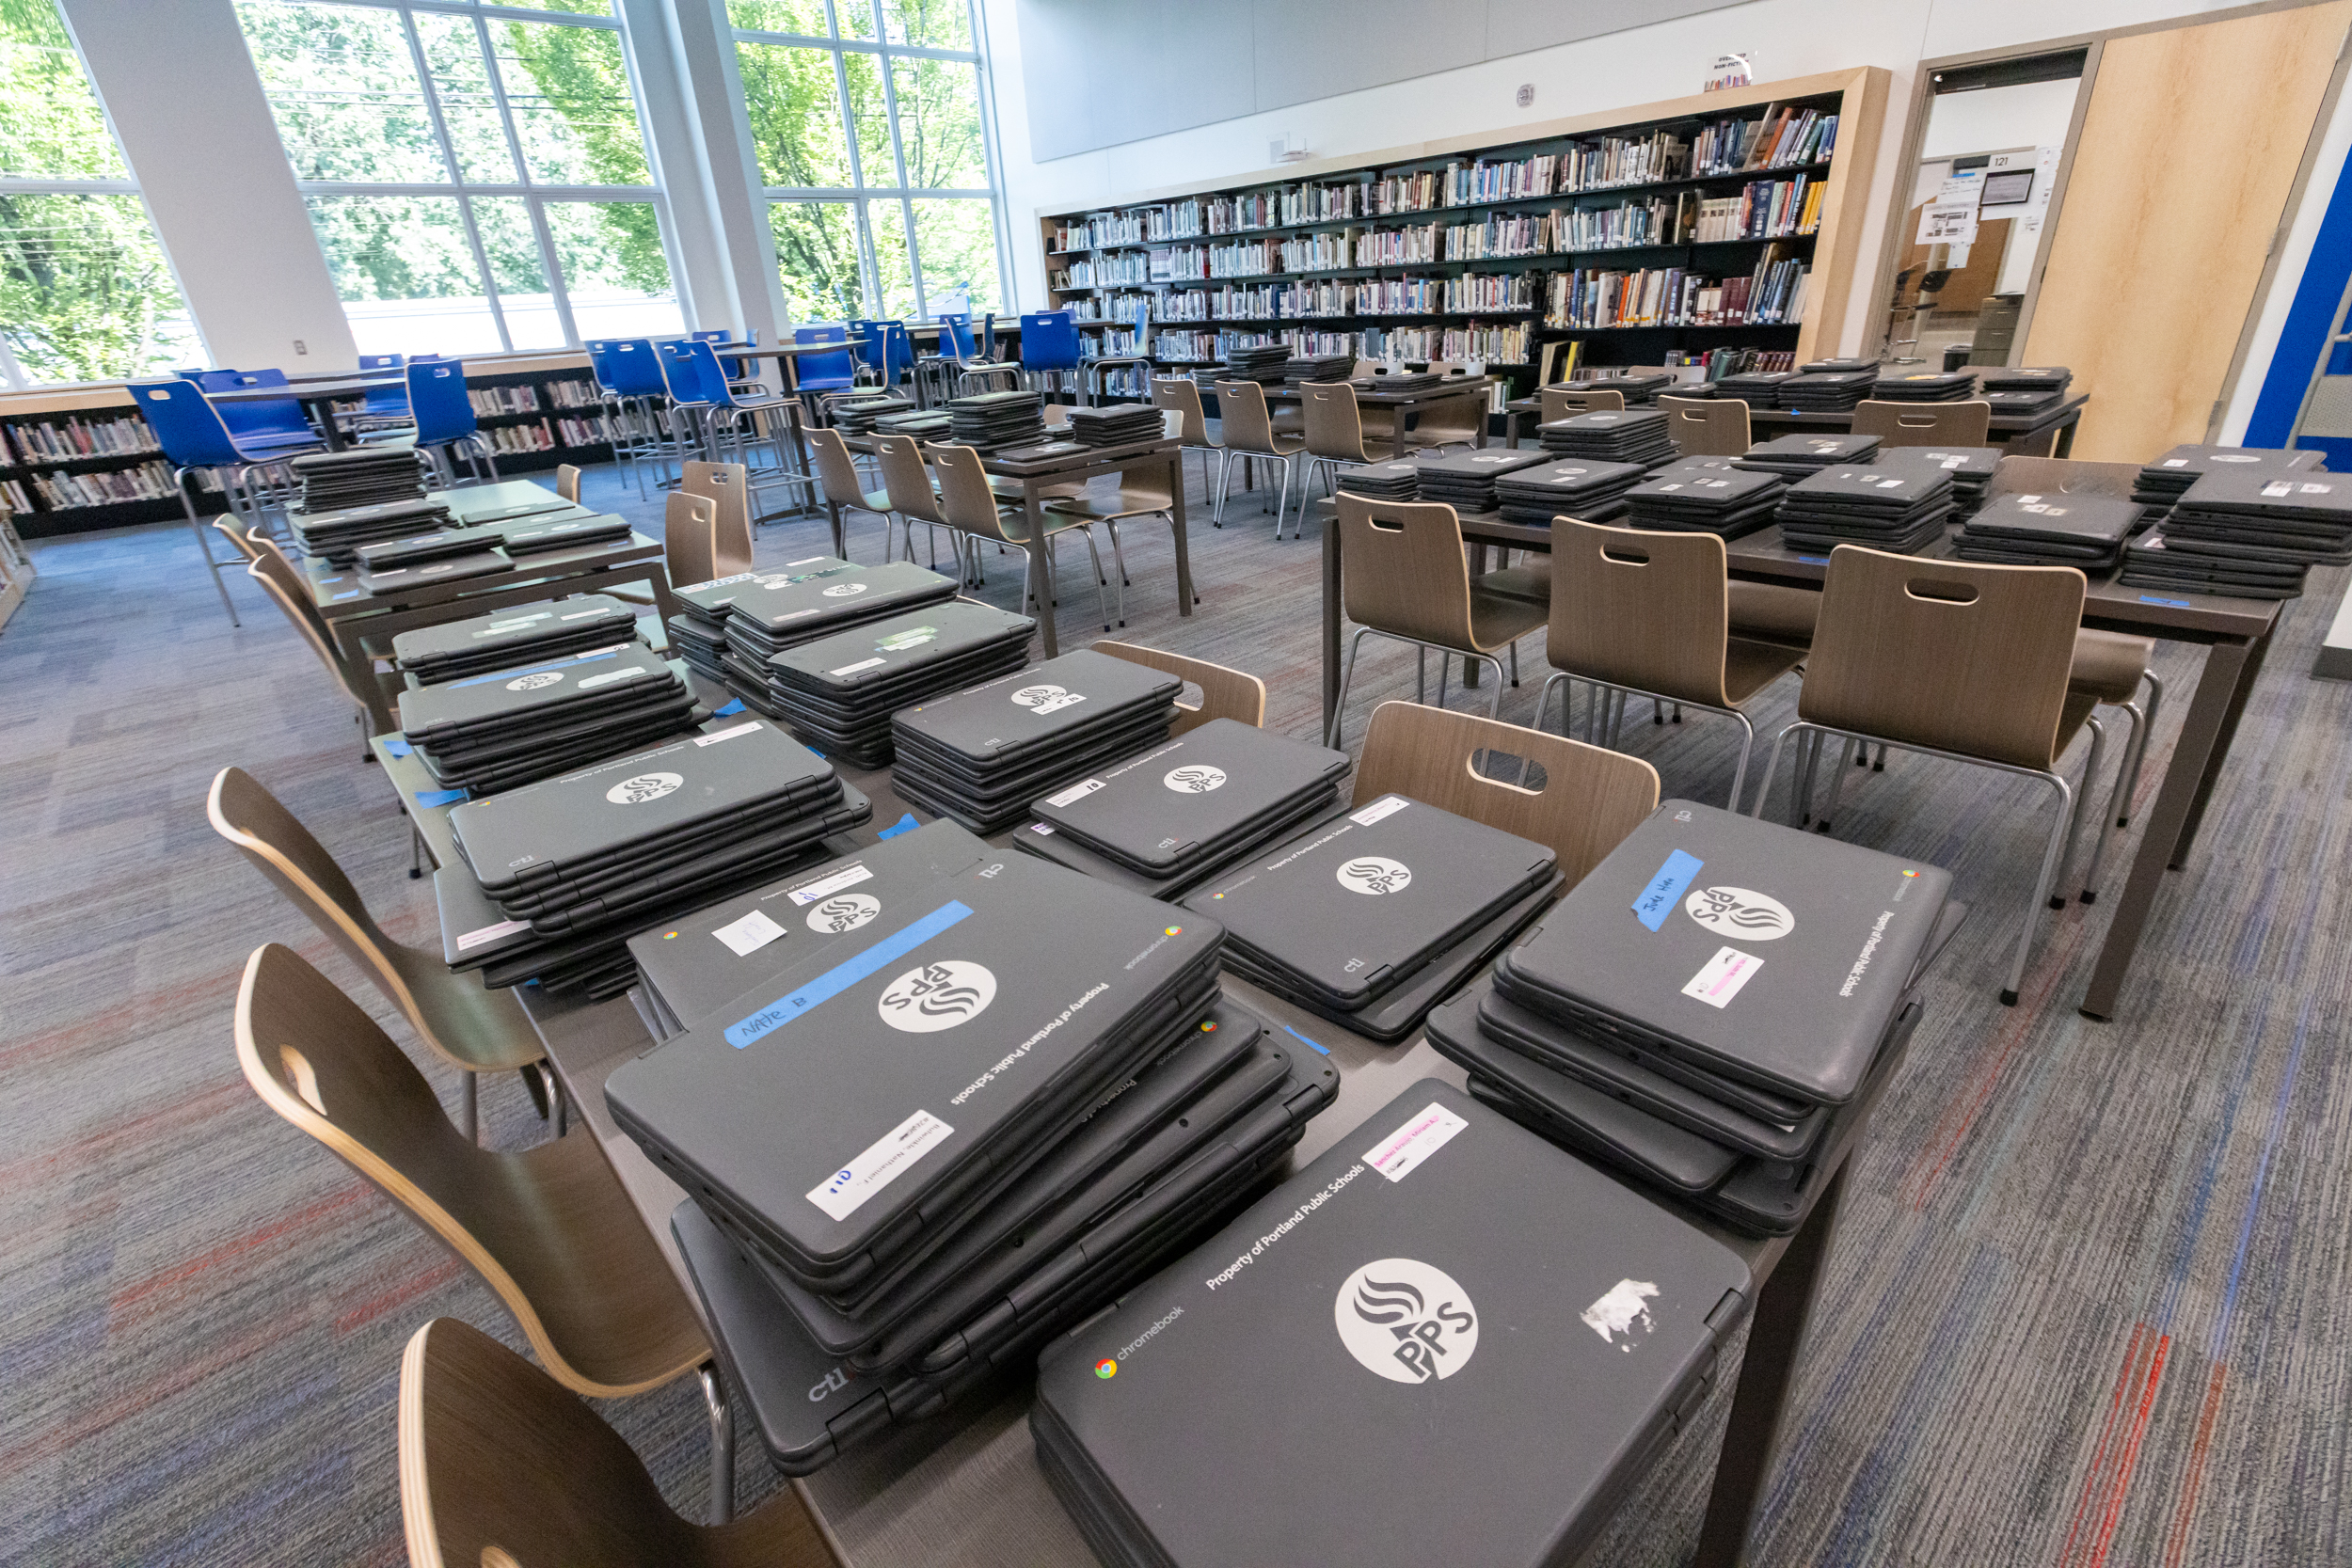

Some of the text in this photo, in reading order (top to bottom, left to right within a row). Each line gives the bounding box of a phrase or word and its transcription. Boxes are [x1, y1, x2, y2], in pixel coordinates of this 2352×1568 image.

[1713, 59, 1750, 70] NON-FICTN
[1994, 156, 2010, 167] 121
[559, 768, 592, 784] Property
[601, 755, 633, 771] Portland
[632, 749, 656, 762] Public
[655, 741, 684, 755] Schools
[1104, 767, 1129, 779] Property
[1266, 857, 1292, 870] Property
[1295, 842, 1319, 855] Portland
[1316, 834, 1333, 845] Public
[1331, 824, 1353, 837] Schools
[760, 888, 787, 900] Property
[795, 875, 820, 887] Portland
[820, 868, 838, 877] Public
[839, 859, 862, 869] Schools
[1871, 911, 1895, 932] Property
[791, 997, 807, 1007] B
[1838, 972, 1860, 997] Schools
[950, 982, 1109, 1104] Property of Portland Public Schools
[1375, 1148, 1397, 1167] Sanchez
[1411, 1122, 1431, 1137] Miriam
[868, 1151, 905, 1180] Nathaniel
[1205, 1252, 1252, 1290] Property
[1251, 1241, 1264, 1255] of
[1260, 1210, 1304, 1246] Portland
[1299, 1190, 1332, 1214] Public
[1327, 1164, 1364, 1193] Schools
[1117, 1306, 1185, 1361] chromebook
